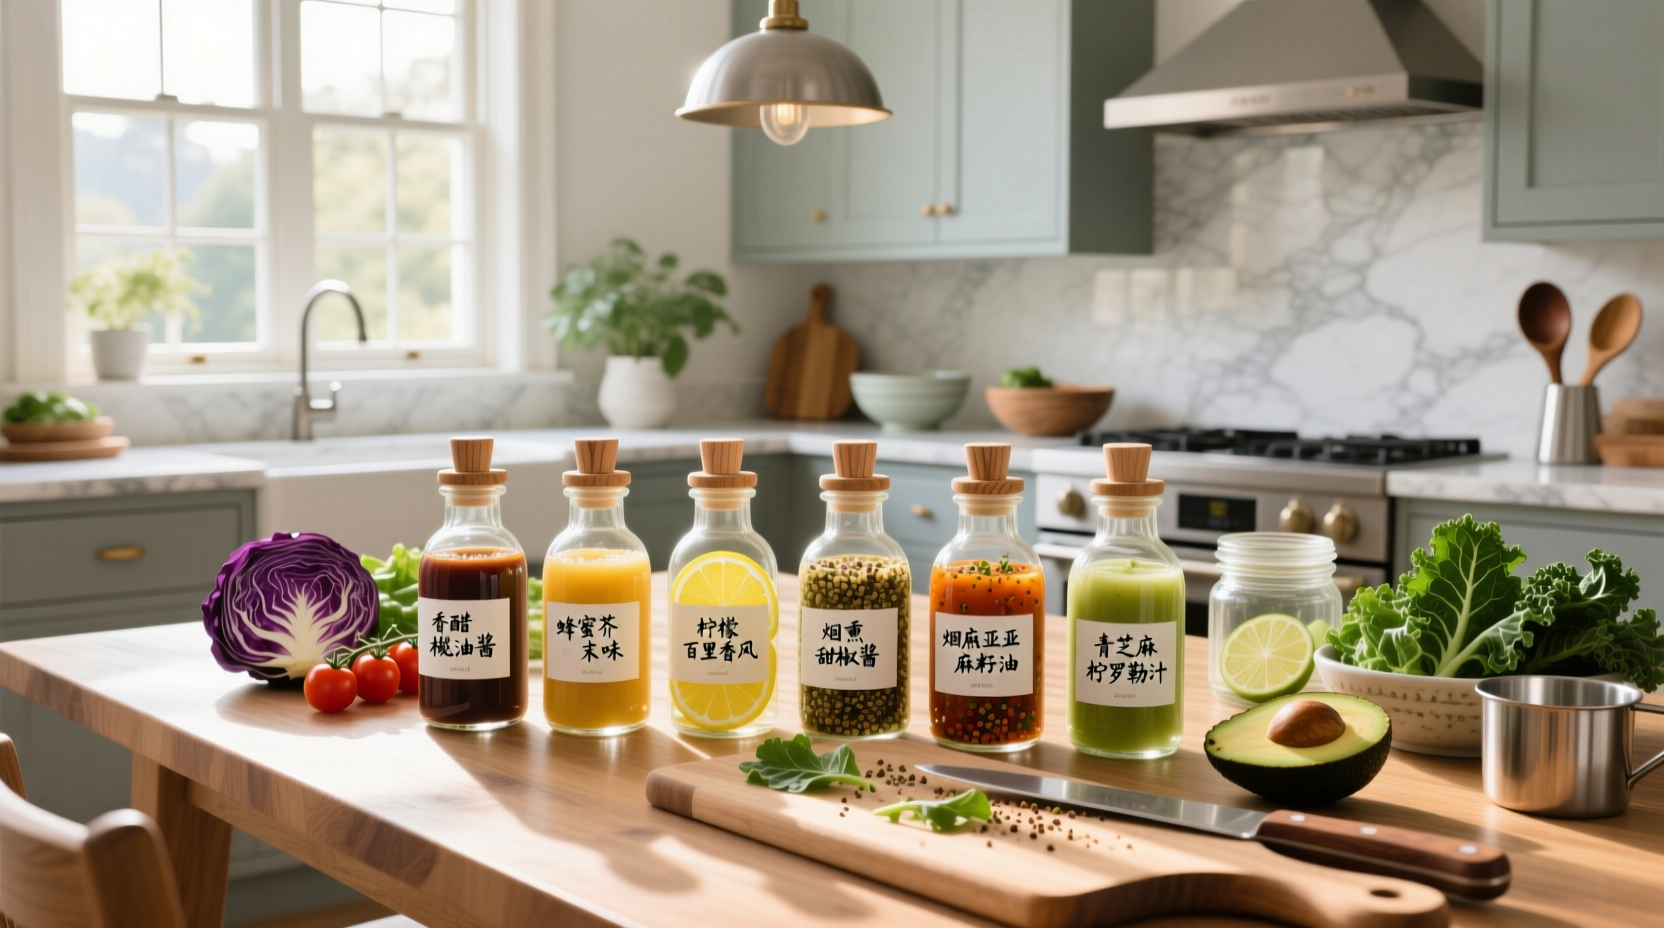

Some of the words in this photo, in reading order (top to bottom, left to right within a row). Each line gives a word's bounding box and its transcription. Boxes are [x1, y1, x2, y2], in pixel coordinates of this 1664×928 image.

[432, 611, 473, 635] 香醋
[556, 613, 619, 642] 蜂蜜芥
[696, 616, 739, 640] 柠檬
[581, 639, 624, 663] 末味
[683, 639, 759, 663] 百里香风
[814, 642, 880, 668] 甜椒酱
[1093, 632, 1159, 659] 青芝麻
[953, 652, 1020, 674] 麻籽油
[1085, 659, 1168, 685] 柠罗勒汁
